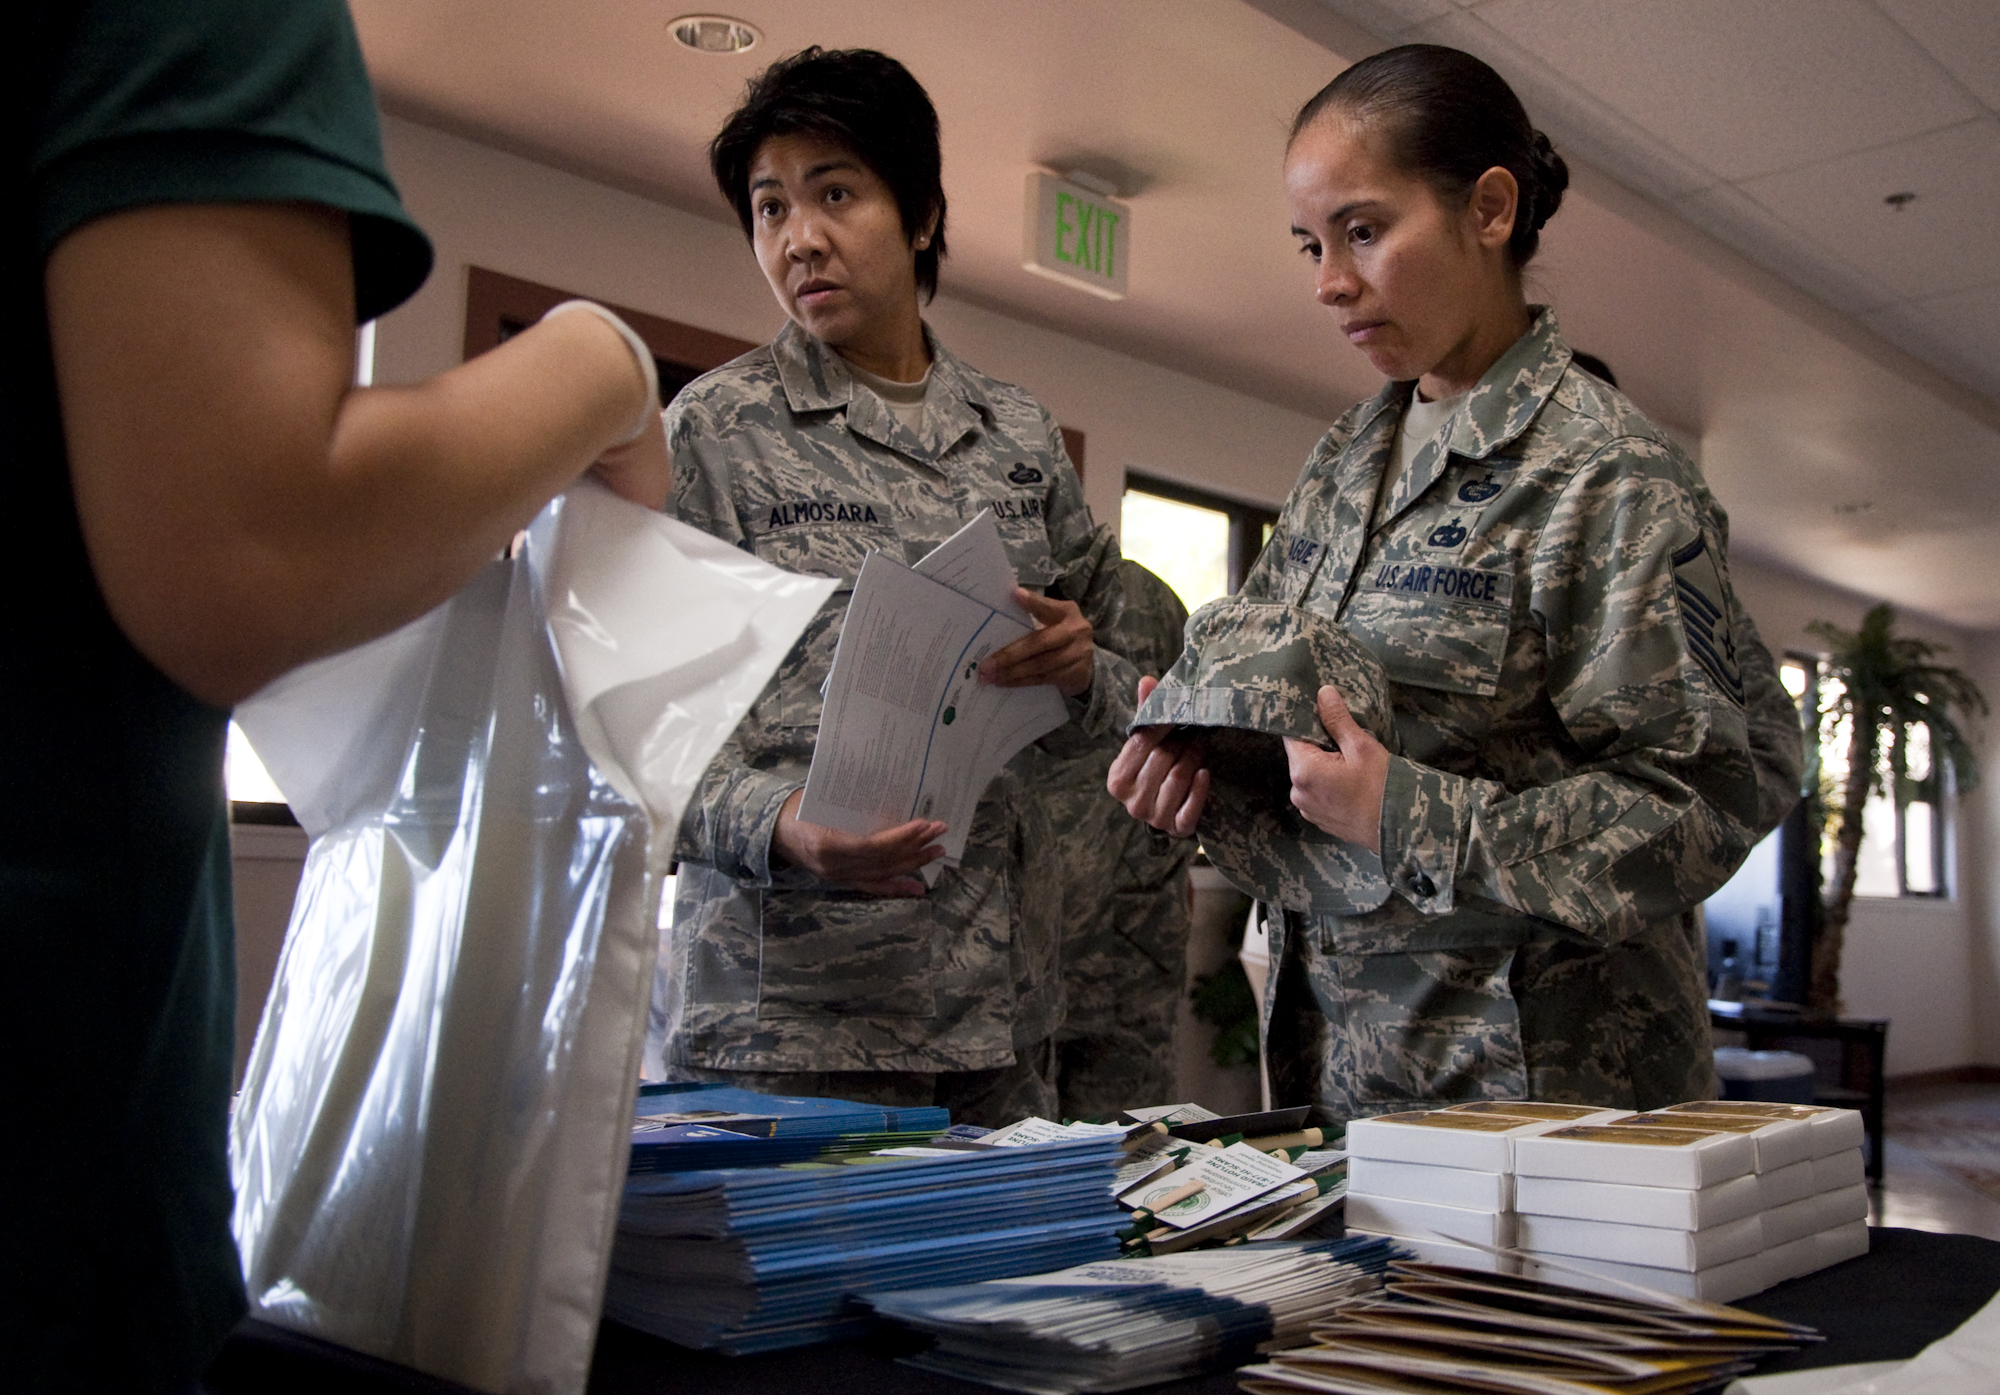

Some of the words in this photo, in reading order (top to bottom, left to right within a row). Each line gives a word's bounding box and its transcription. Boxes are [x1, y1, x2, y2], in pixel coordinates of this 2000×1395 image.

[1056, 192, 1119, 278] EXIT
[769, 502, 878, 529] ALMOSARA
[992, 500, 1020, 519] U.S.
[1021, 498, 1042, 519] AIR
[1376, 565, 1399, 589] U.S.
[1400, 566, 1431, 592] AIR
[1432, 567, 1497, 601] FORCE
[1200, 1167, 1251, 1191] Commissioner
[1204, 1160, 1241, 1177] HOTLINE
[1211, 1155, 1276, 1185] 1-877-HI-SCAMS
[1200, 1174, 1236, 1192] Securities
[1239, 1175, 1268, 1188] FRAUD
